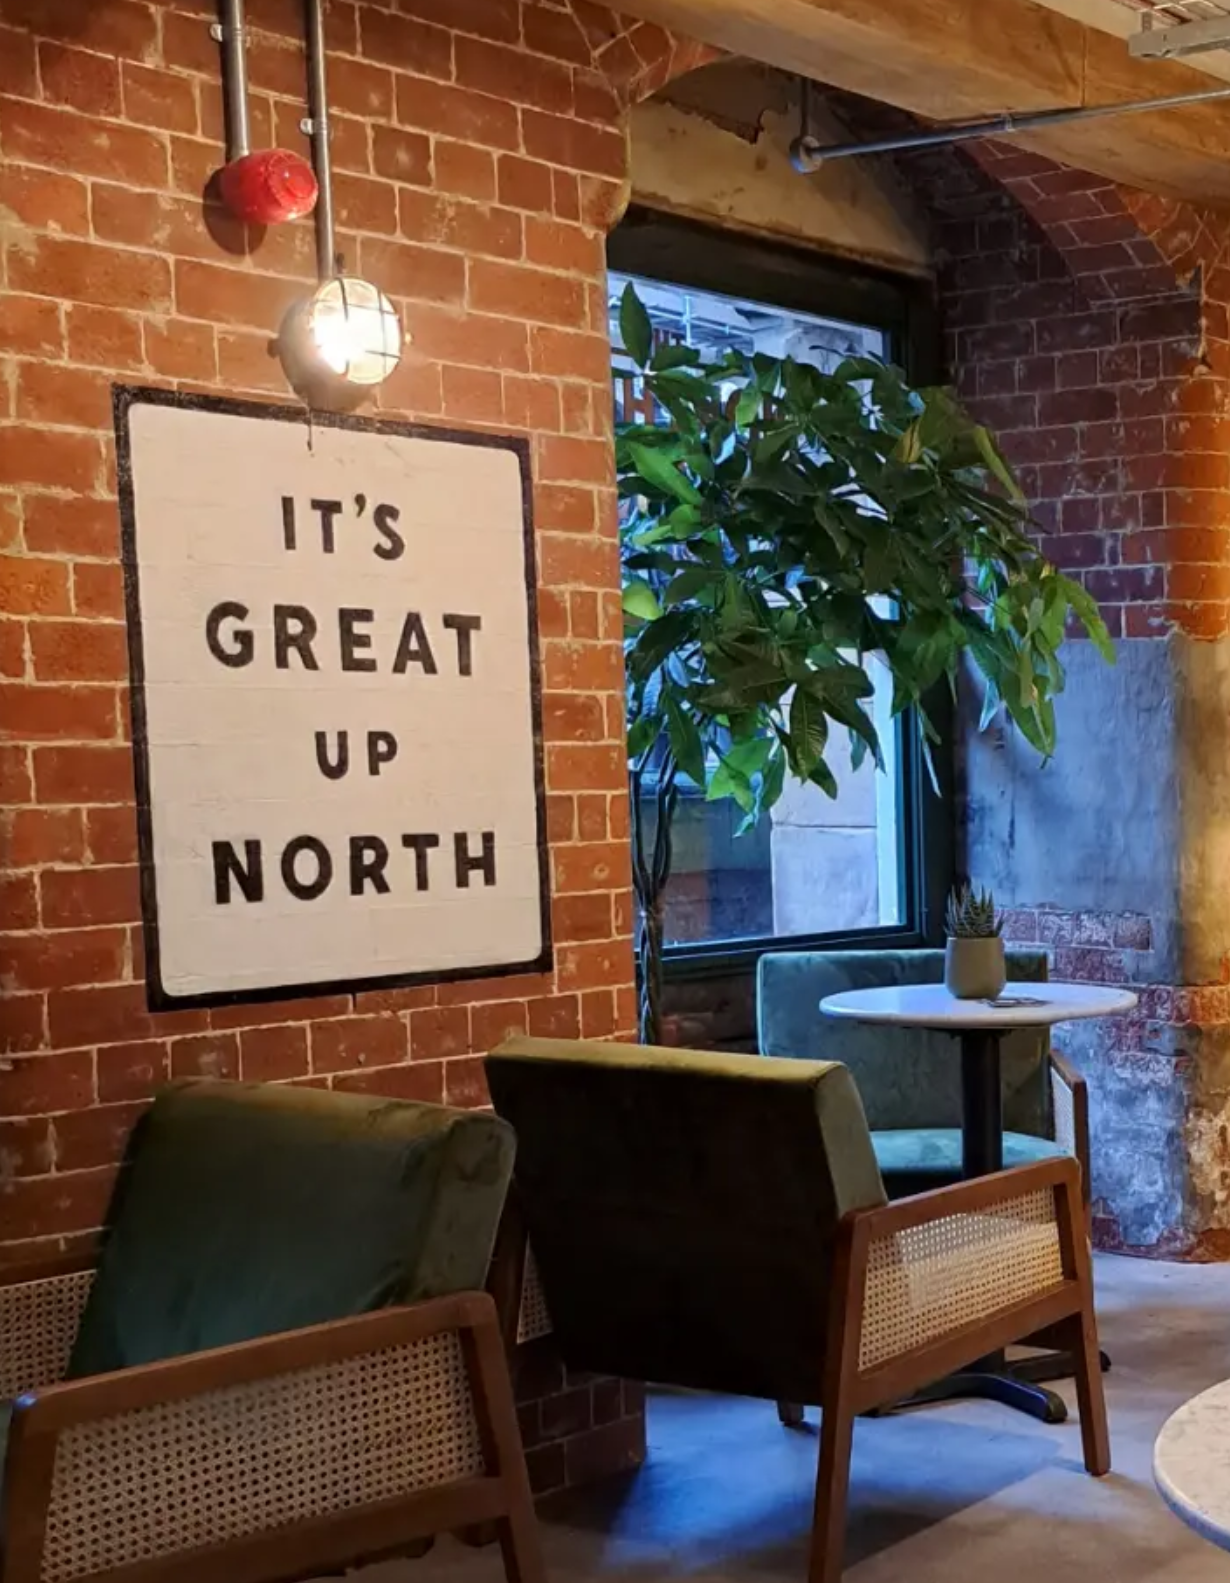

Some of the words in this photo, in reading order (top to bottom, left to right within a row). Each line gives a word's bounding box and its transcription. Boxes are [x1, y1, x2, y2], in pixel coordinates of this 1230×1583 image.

[281, 493, 406, 562] IT'S
[205, 601, 482, 677] GREAT
[315, 731, 398, 780] UP
[212, 831, 496, 905] NORTH
